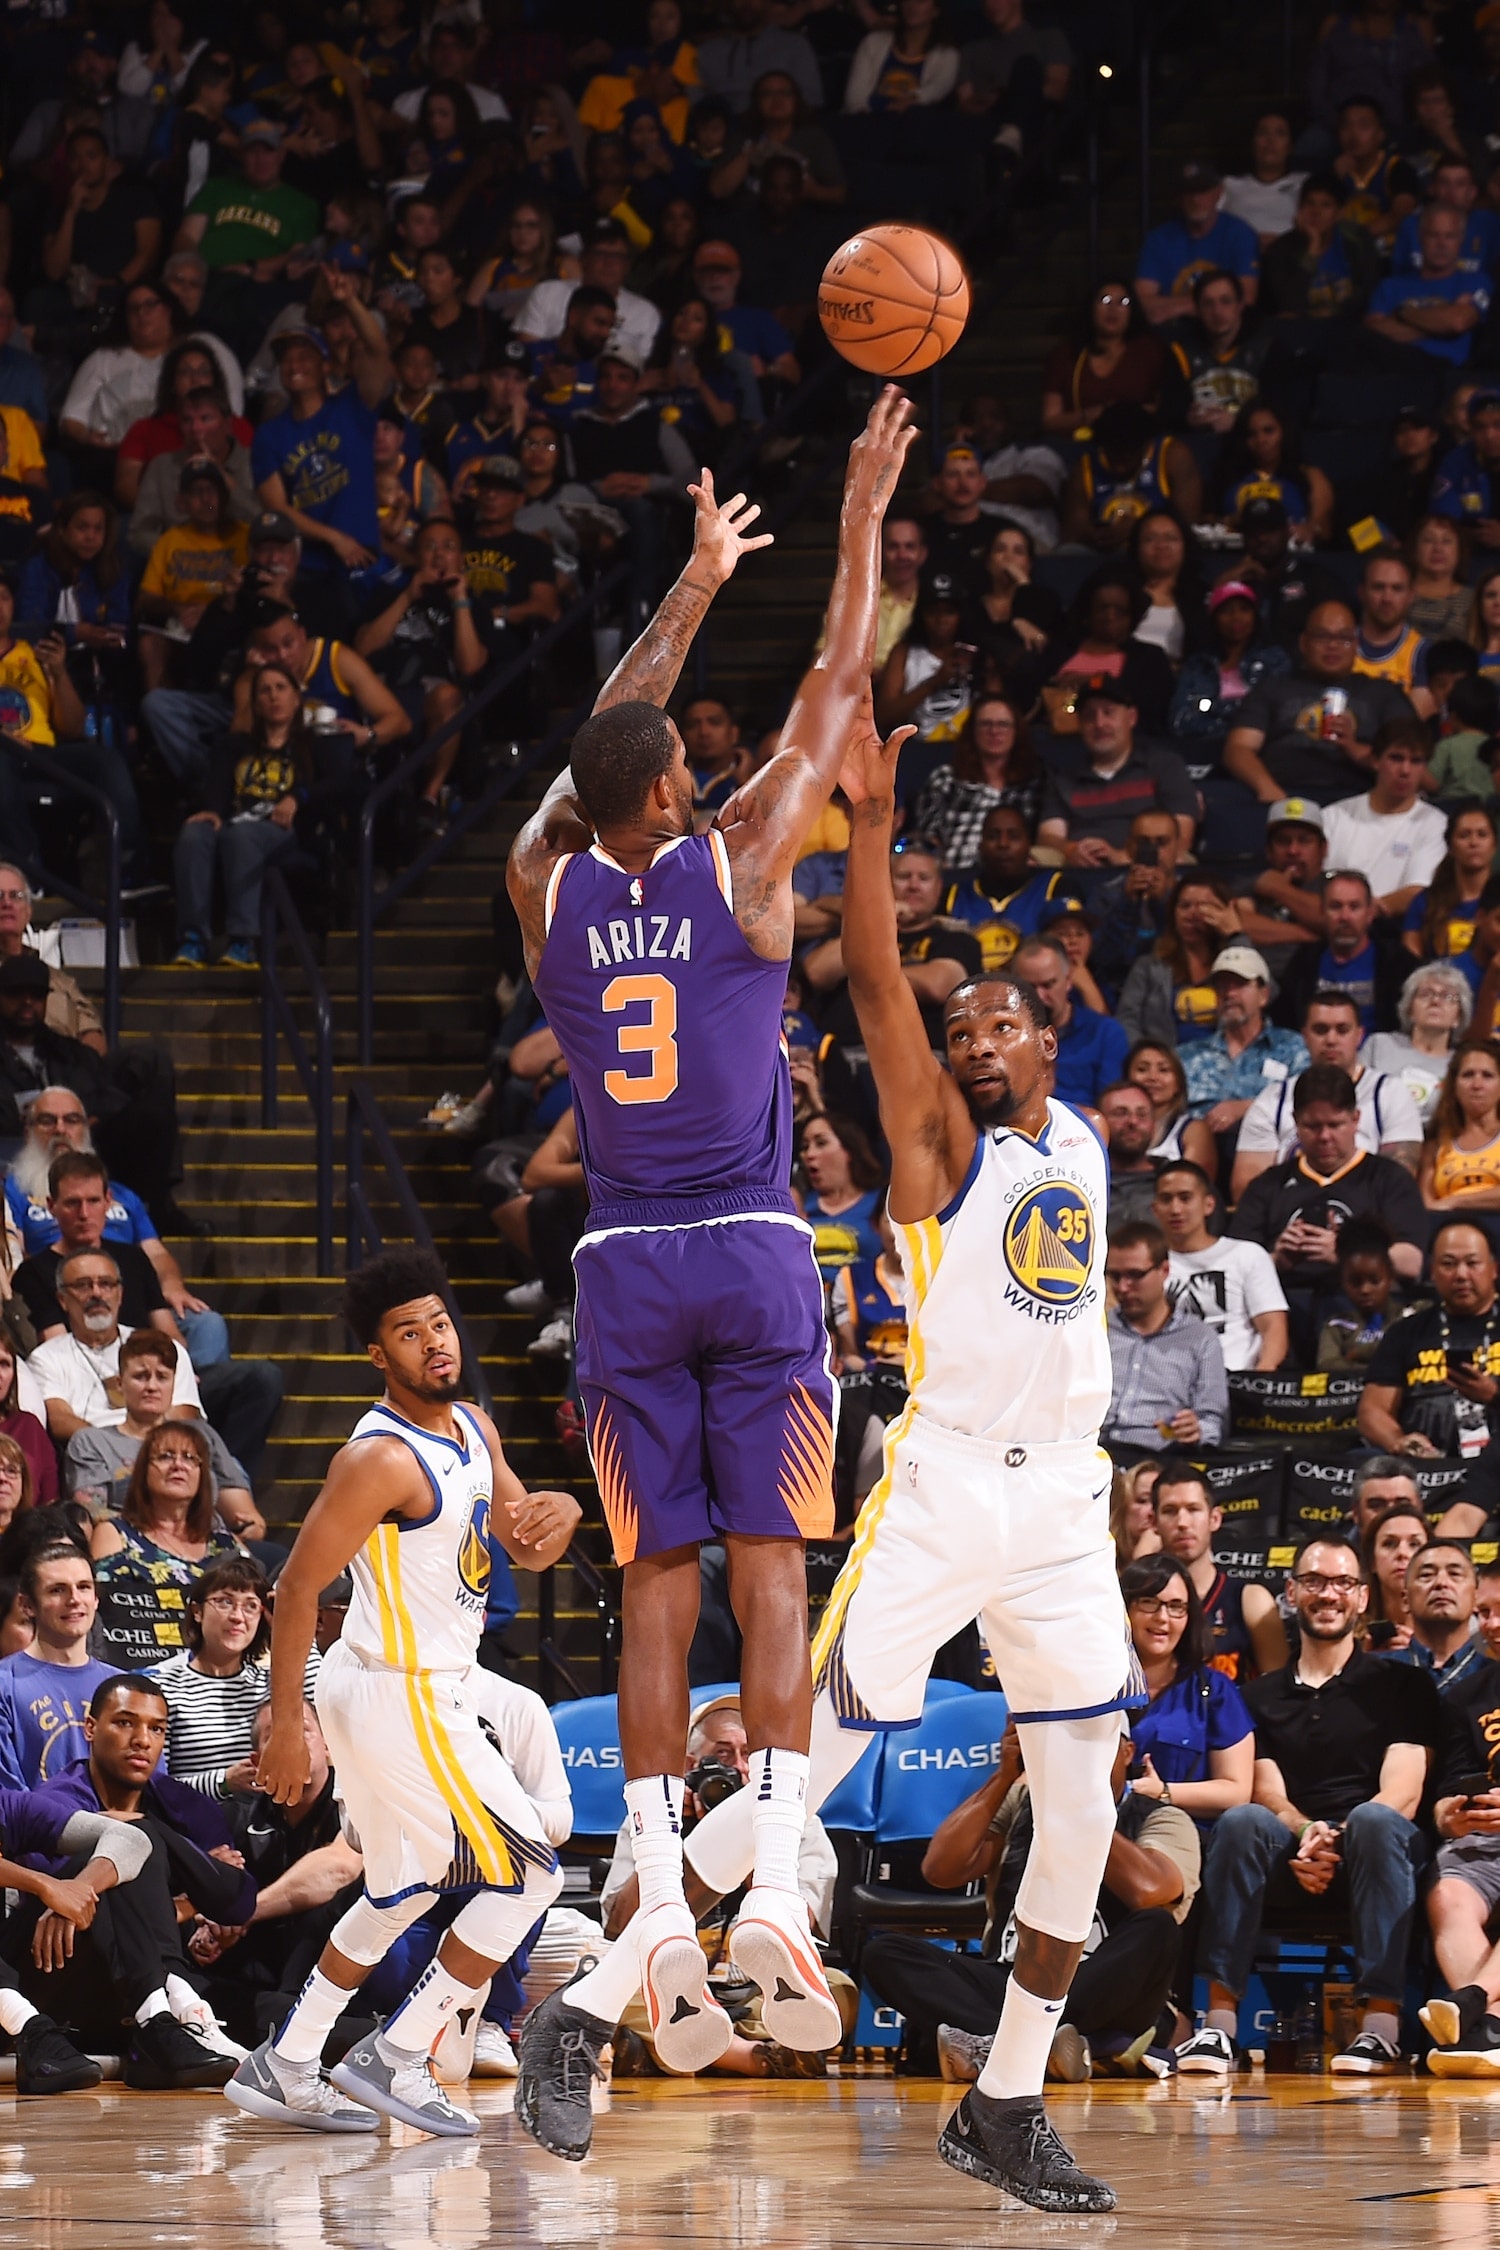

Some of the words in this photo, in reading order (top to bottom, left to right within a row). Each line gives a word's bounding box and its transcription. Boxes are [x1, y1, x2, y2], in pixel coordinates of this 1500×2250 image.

[215, 203, 282, 239] OAKLAND
[819, 299, 874, 324] SPALD
[586, 915, 693, 970] ARIZA
[601, 972, 679, 1106] 3
[1003, 1166, 1066, 1205] GOLDEN
[1056, 1206, 1088, 1243] 35
[1003, 1281, 1098, 1326] WARRORS
[840, 1371, 874, 1389] EEK
[1236, 1414, 1358, 1434] cachecreek.co
[1294, 1460, 1355, 1483] CACH
[1416, 1468, 1468, 1488] REEK
[806, 1551, 842, 1567] CAC
[102, 1626, 154, 1645] ACHE
[125, 1647, 171, 1658] CASINO
[30, 1695, 52, 1716] The
[560, 1745, 625, 1769] HAS
[898, 1742, 1002, 1771] CHASE
